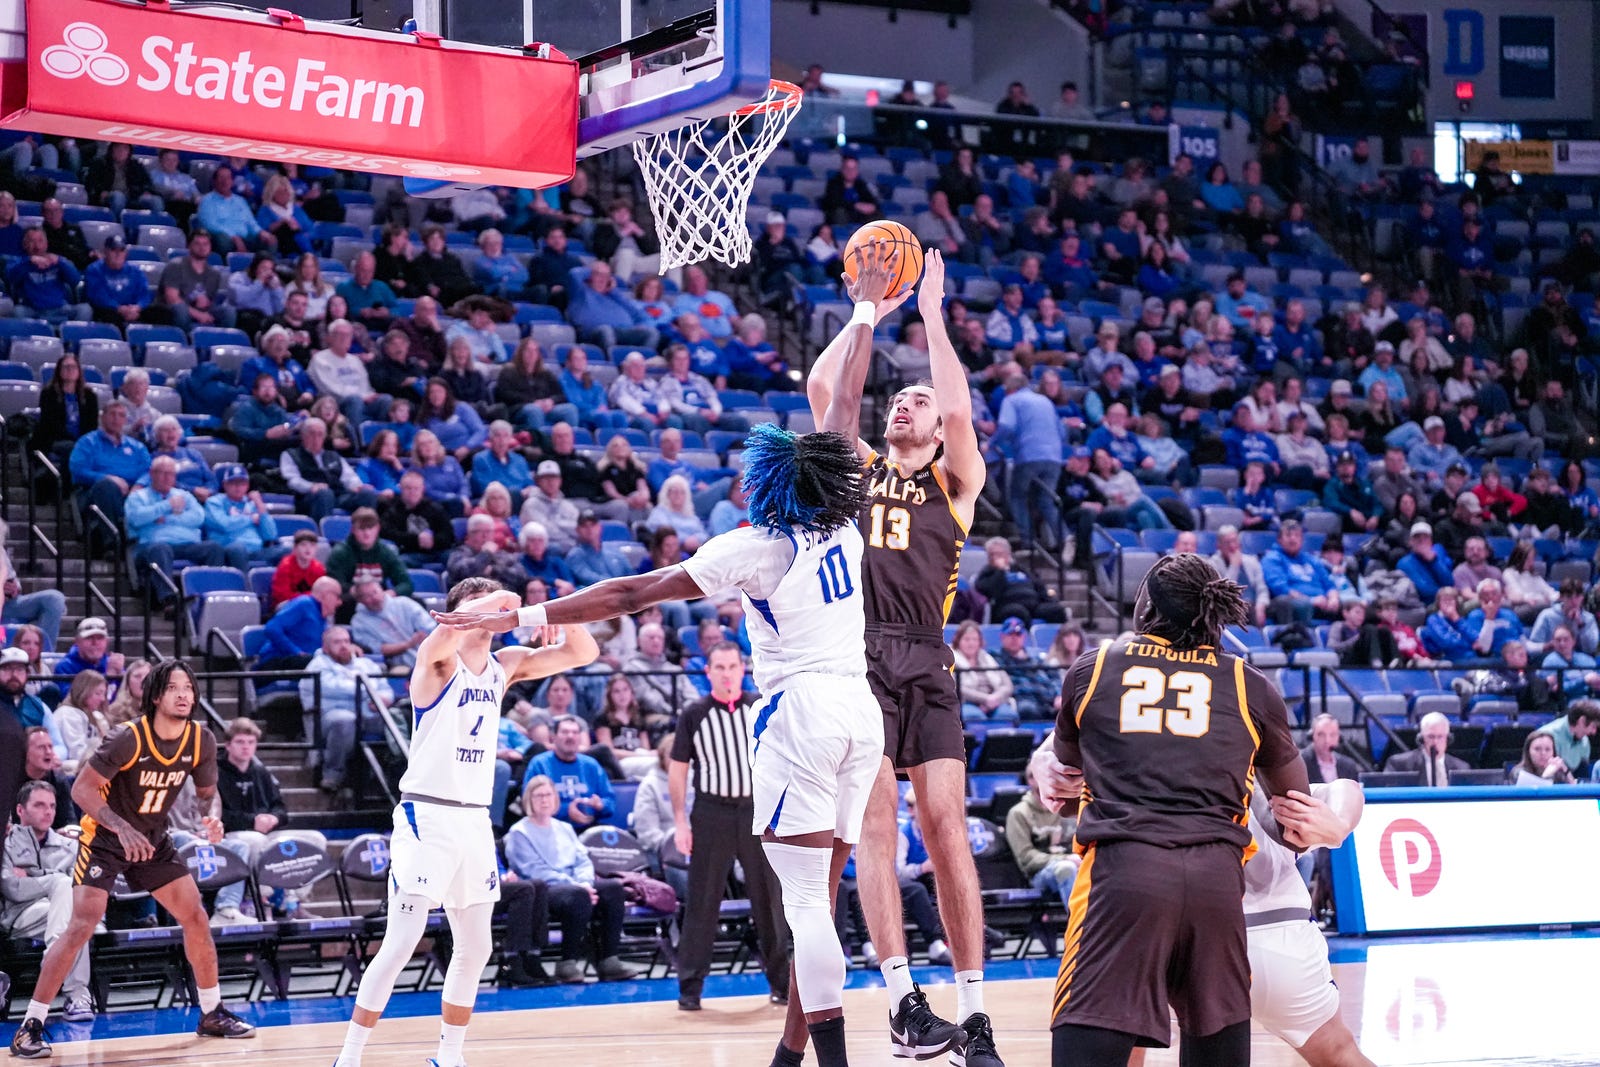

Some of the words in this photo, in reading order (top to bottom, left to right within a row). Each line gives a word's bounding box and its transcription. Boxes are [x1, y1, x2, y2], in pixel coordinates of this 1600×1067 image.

[1443, 9, 1486, 76] D
[1182, 136, 1217, 158] 105
[866, 476, 927, 506] VALPO
[868, 503, 912, 551] 13
[816, 543, 855, 605] 10
[1119, 665, 1213, 738] 23
[138, 770, 186, 788] VALPO
[138, 788, 169, 814] 11
